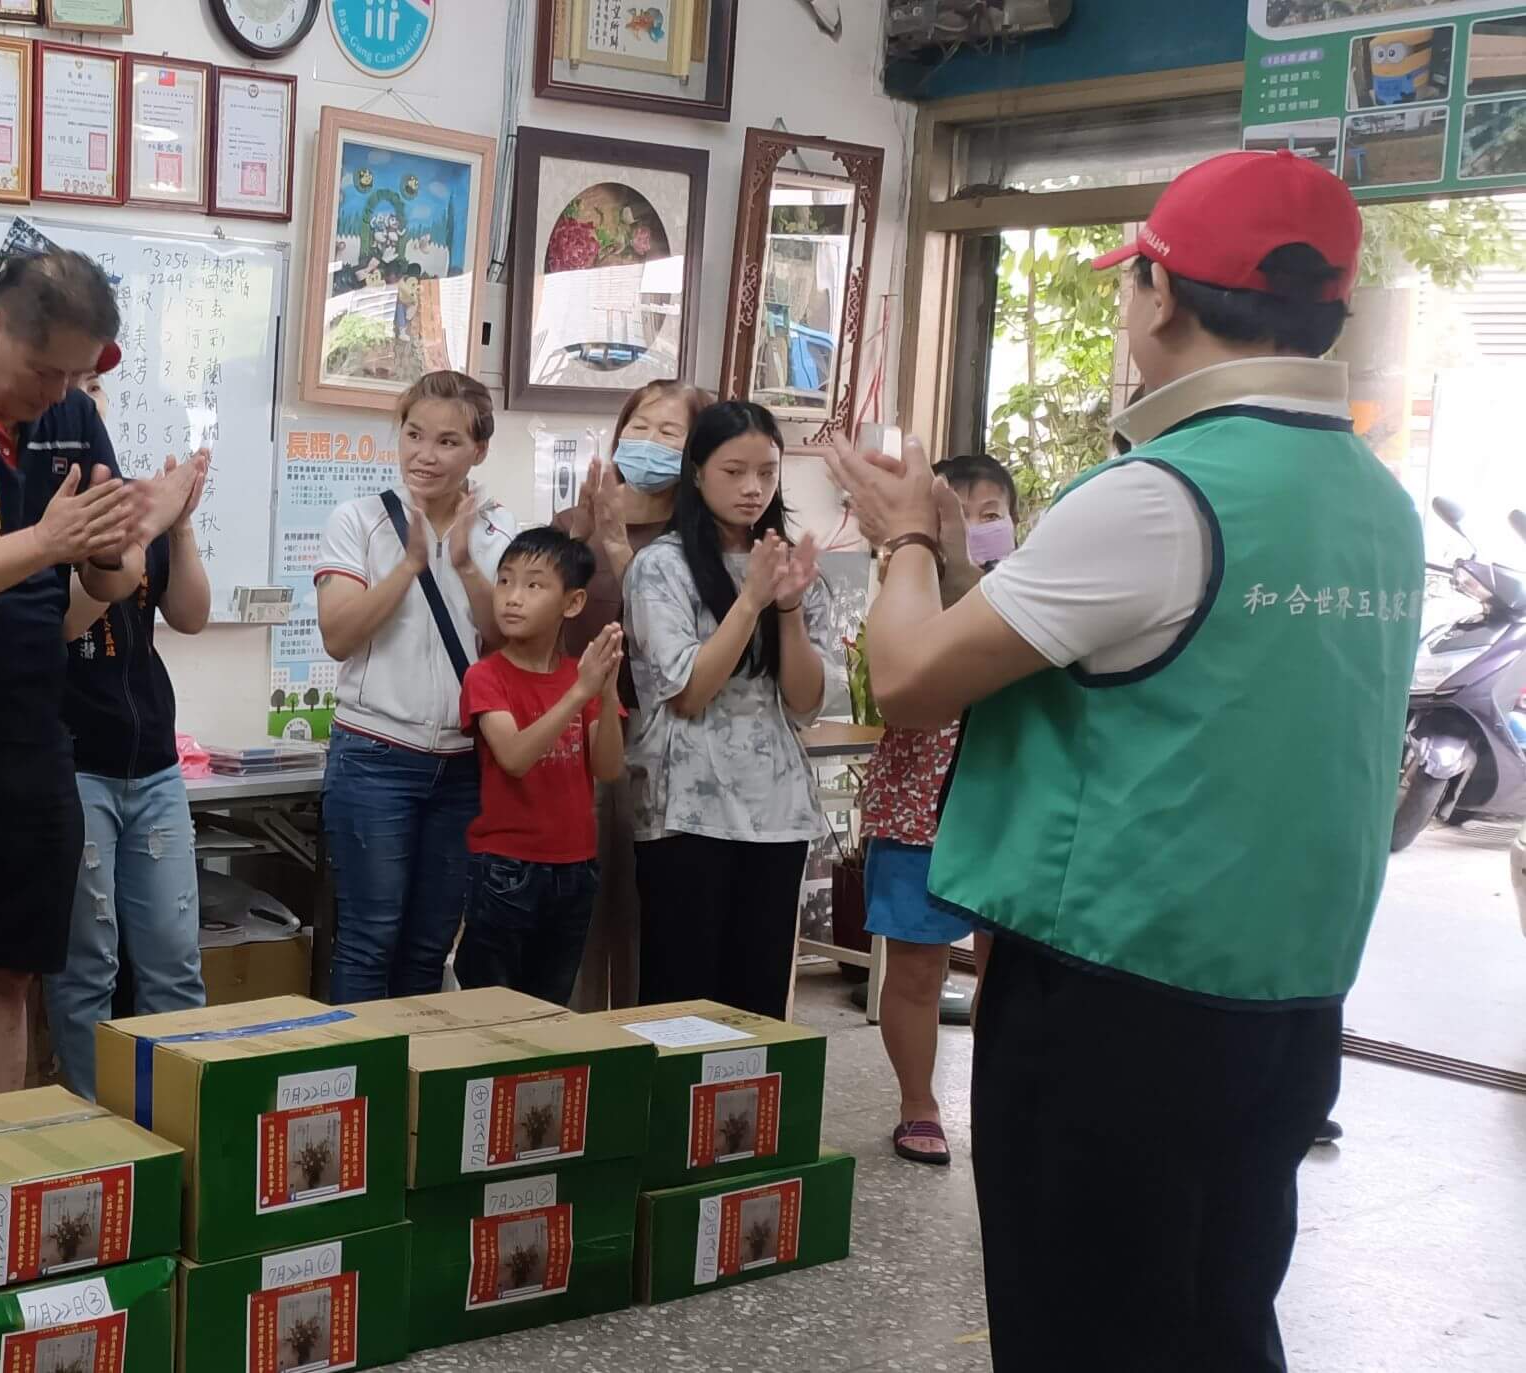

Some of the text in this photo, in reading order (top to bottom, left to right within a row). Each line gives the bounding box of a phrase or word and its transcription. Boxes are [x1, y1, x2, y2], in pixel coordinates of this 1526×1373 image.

[286, 431, 377, 463] 長照2.0
[1243, 583, 1422, 622] 和合世界互家
